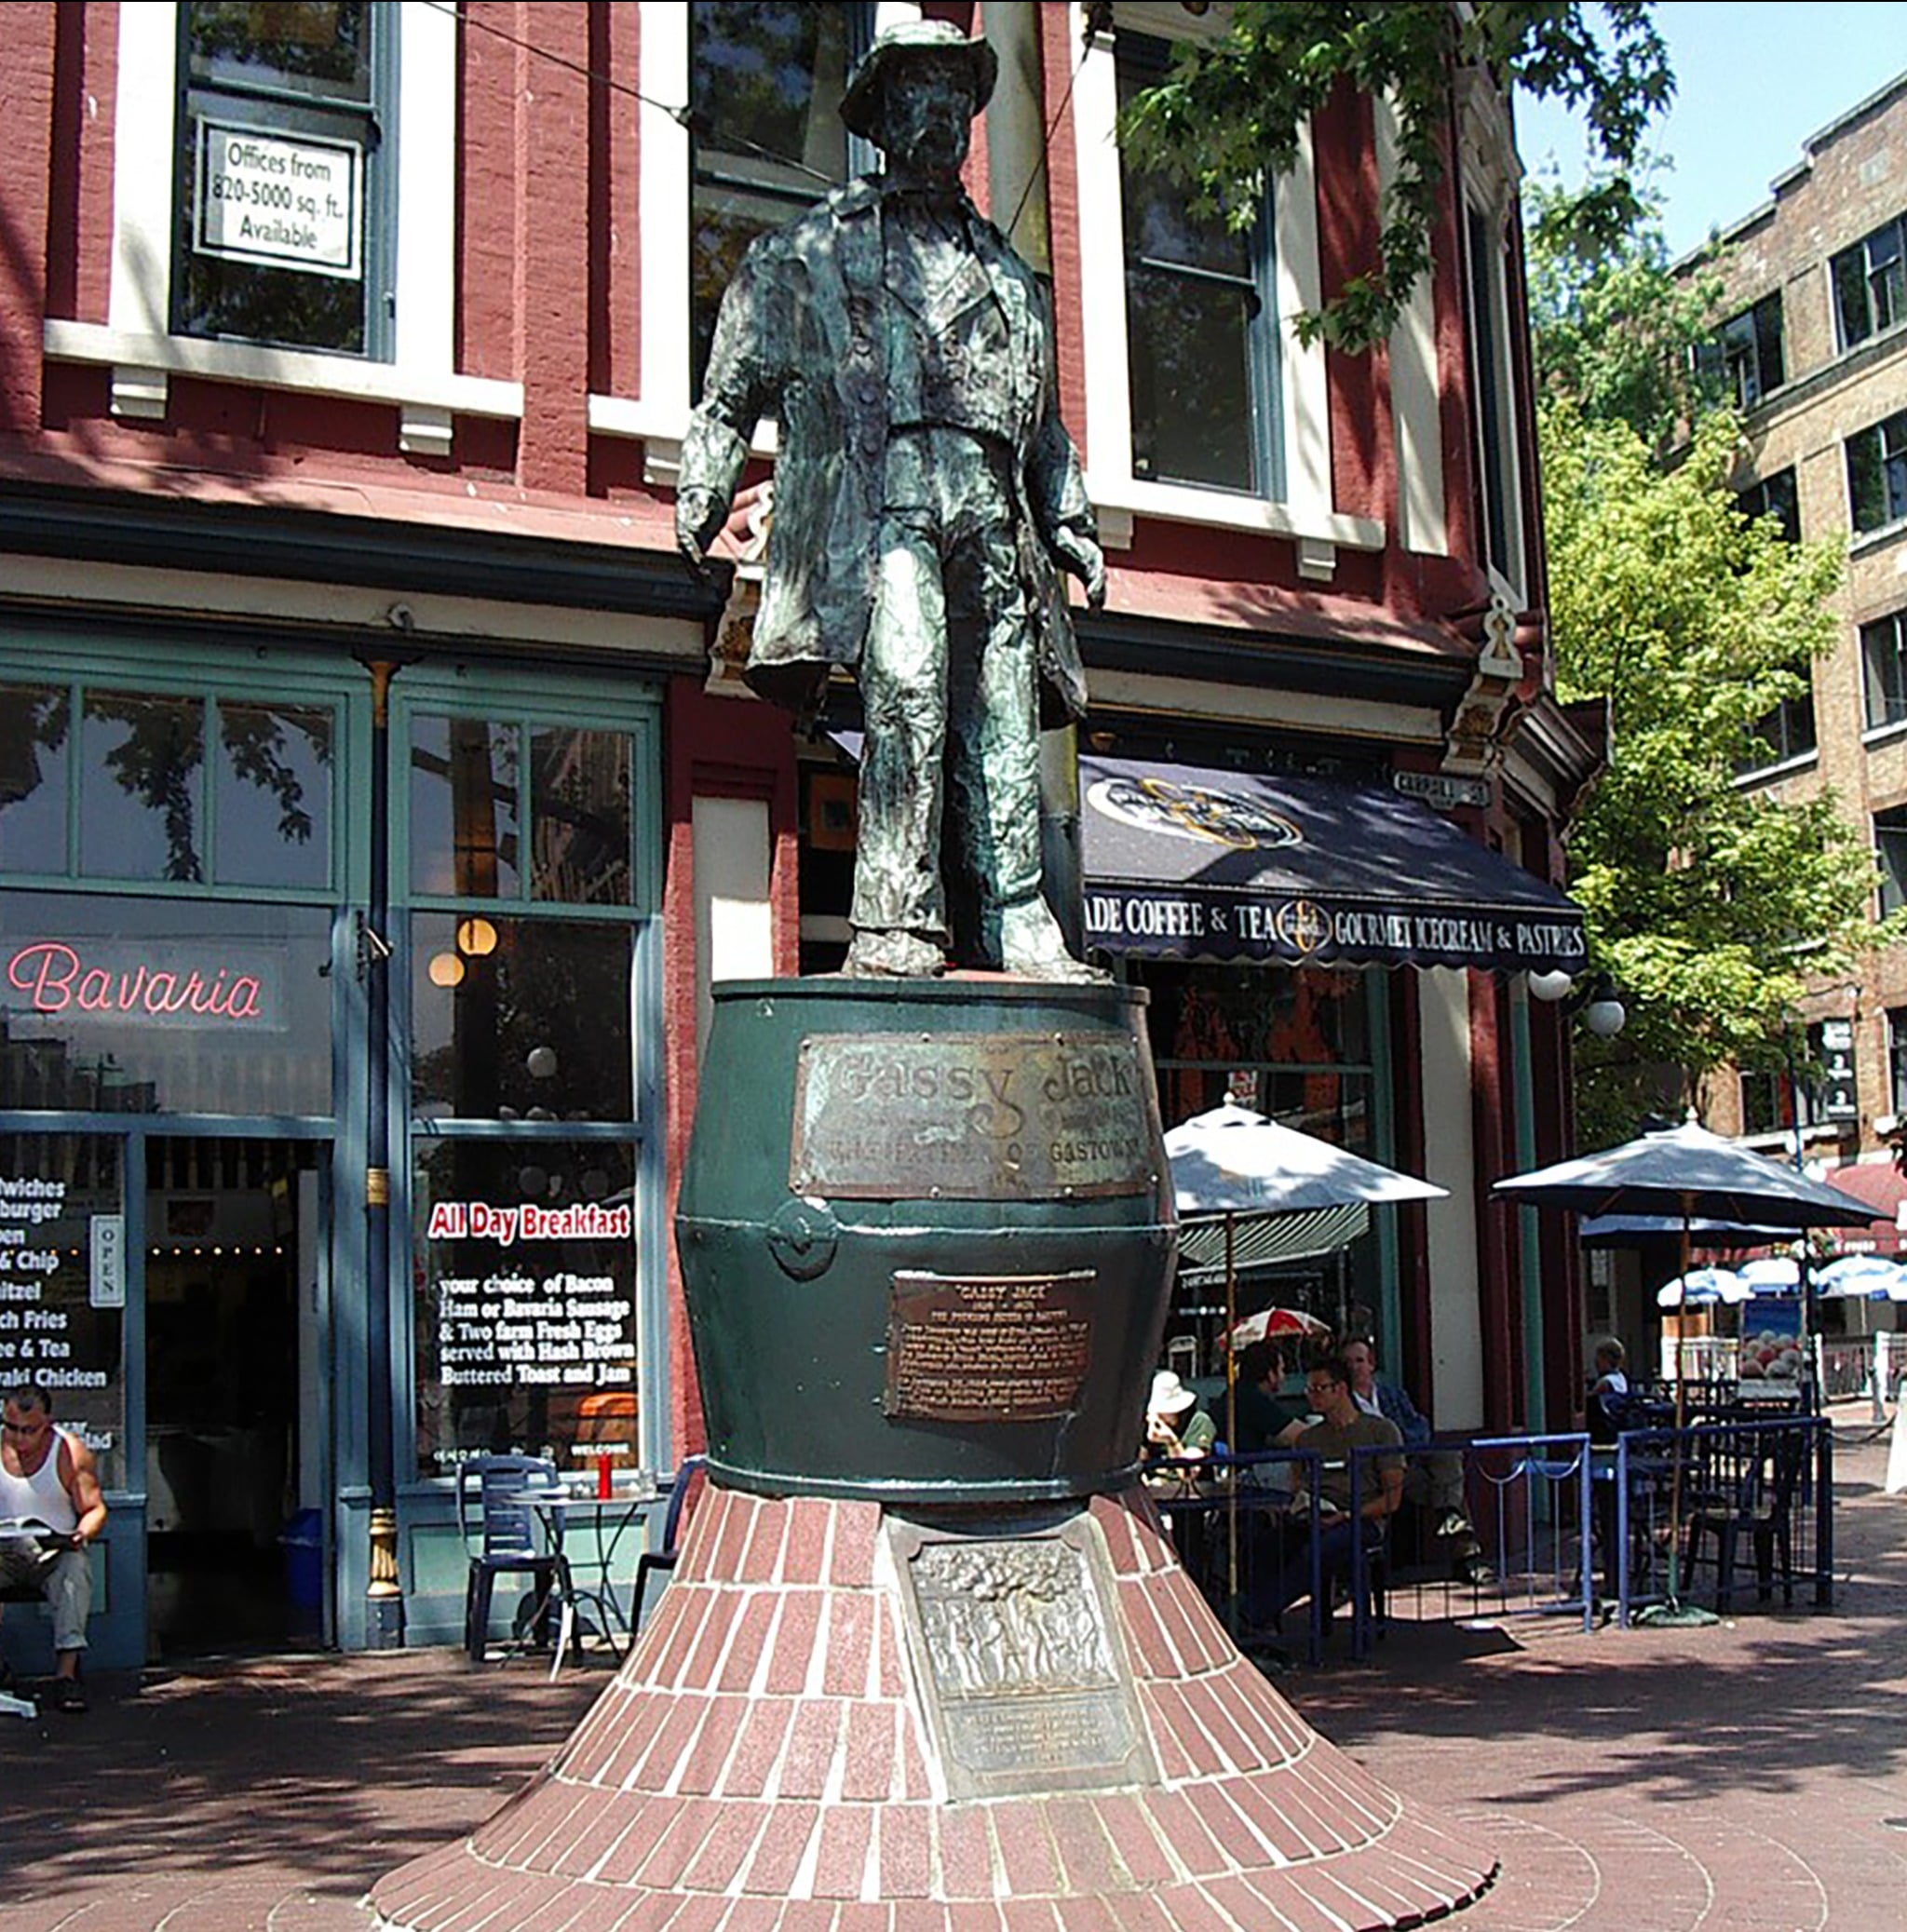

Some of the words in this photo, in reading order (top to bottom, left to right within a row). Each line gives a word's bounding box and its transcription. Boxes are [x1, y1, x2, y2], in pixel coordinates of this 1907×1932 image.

[228, 142, 286, 174] Offices
[291, 153, 331, 181] from
[212, 174, 292, 209] 820-5000
[297, 195, 321, 222] sq.
[326, 194, 344, 218] ft.
[239, 214, 318, 250] Available
[1126, 898, 1205, 937] COFFEE
[1211, 907, 1228, 931] &
[1235, 905, 1277, 940] TEA
[1335, 912, 1413, 948] GOURMET
[1496, 925, 1512, 949] &
[1517, 924, 1584, 956] PASTRIES
[7, 942, 262, 1017] Bavaria
[1042, 1053, 1133, 1102] Jack
[428, 1202, 467, 1238] All
[469, 1202, 517, 1247] Day
[519, 1203, 632, 1239] Breakfast
[17, 1250, 60, 1275] Chip
[440, 1278, 480, 1299] your
[483, 1273, 535, 1294] choice
[544, 1273, 563, 1293] of
[565, 1274, 615, 1293] Bacon
[23, 1310, 68, 1330] Fries
[440, 1299, 479, 1317] Ham
[481, 1302, 501, 1317] or
[503, 1297, 562, 1317] Bavaria
[565, 1298, 630, 1321] Sausage
[439, 1322, 454, 1342] &
[457, 1323, 494, 1341] Two
[495, 1320, 534, 1341] farm
[536, 1320, 582, 1341] Fresh
[584, 1321, 623, 1344] Eggs
[20, 1339, 34, 1358] &
[38, 1339, 71, 1358] Tea
[440, 1342, 494, 1362] served
[497, 1342, 535, 1360] with
[537, 1341, 580, 1361] Hash
[582, 1341, 635, 1359] Brown
[34, 1368, 107, 1387] Chicken
[440, 1363, 512, 1385] Buttered
[515, 1364, 561, 1384] Toast
[563, 1362, 594, 1383] and
[596, 1363, 631, 1386] Jam
[571, 1443, 629, 1455] WELCOME
